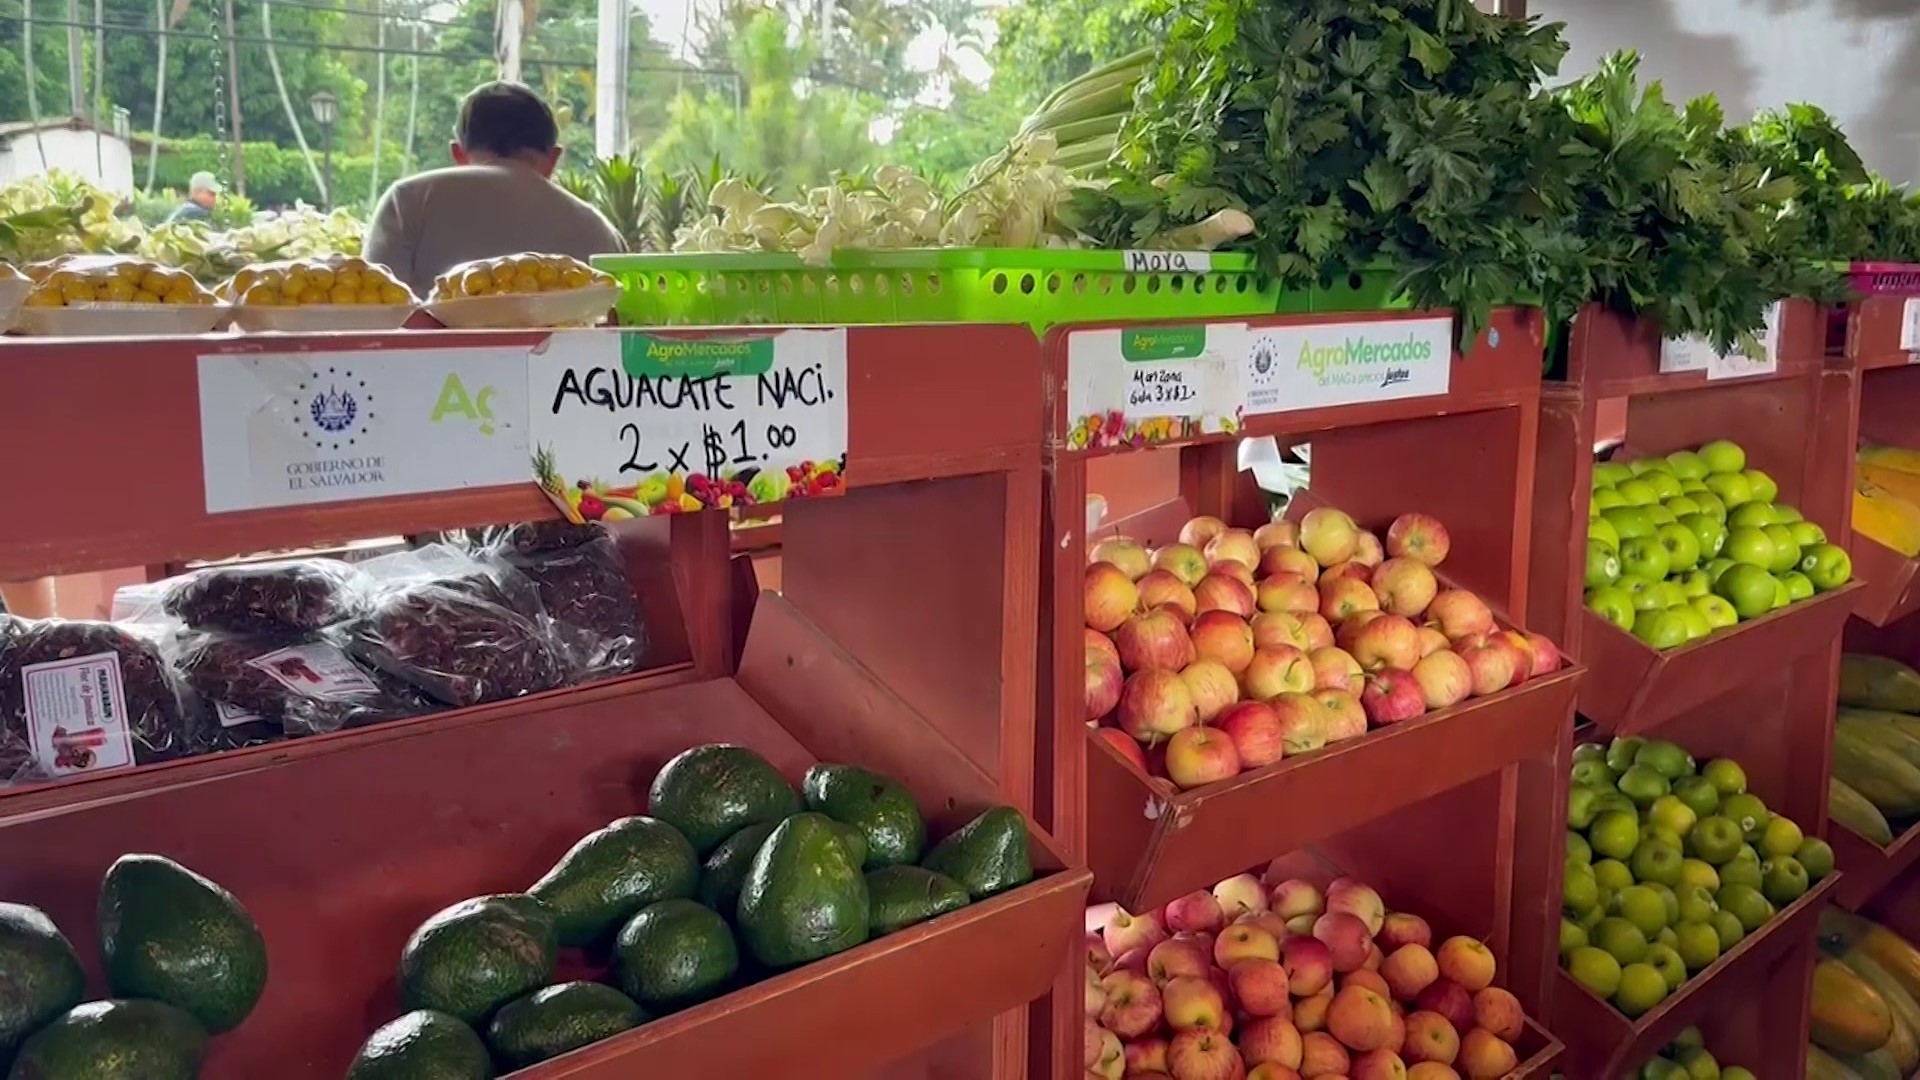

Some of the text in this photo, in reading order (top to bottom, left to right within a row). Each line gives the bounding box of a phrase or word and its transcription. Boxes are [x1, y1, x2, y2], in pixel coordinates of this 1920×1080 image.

[1297, 332, 1431, 378] AgroMercados
[552, 367, 734, 414] AGUACATE
[286, 456, 384, 475] GOBIERNO DE
[619, 423, 657, 474] 2
[703, 420, 797, 482] $1.00
[288, 470, 384, 490] EL SALVADOR
